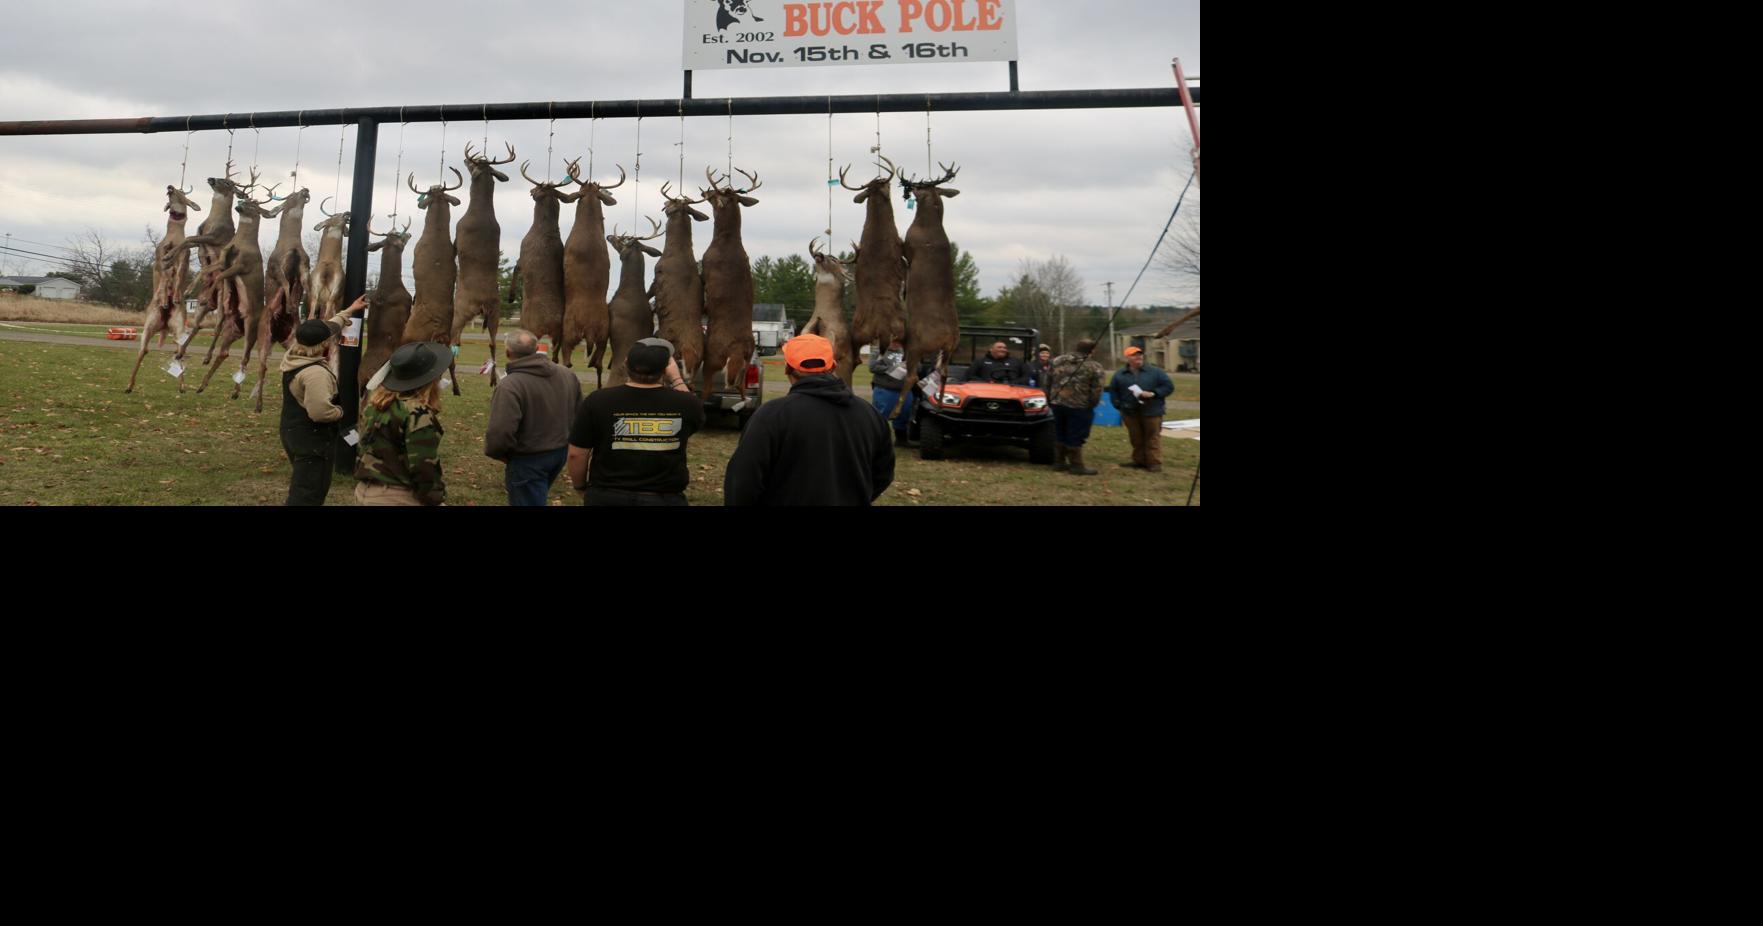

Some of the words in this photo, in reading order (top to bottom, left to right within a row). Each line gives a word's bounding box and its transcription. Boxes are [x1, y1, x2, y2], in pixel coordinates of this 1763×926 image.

[783, 1, 886, 36] BUCK
[898, 0, 1003, 32] POLE
[702, 34, 729, 44] Est.
[735, 31, 775, 43] 2002
[726, 49, 784, 64] Nov.
[793, 45, 859, 62] 15th
[868, 44, 891, 59] &
[901, 42, 968, 59] 16th
[623, 419, 673, 434] TBC
